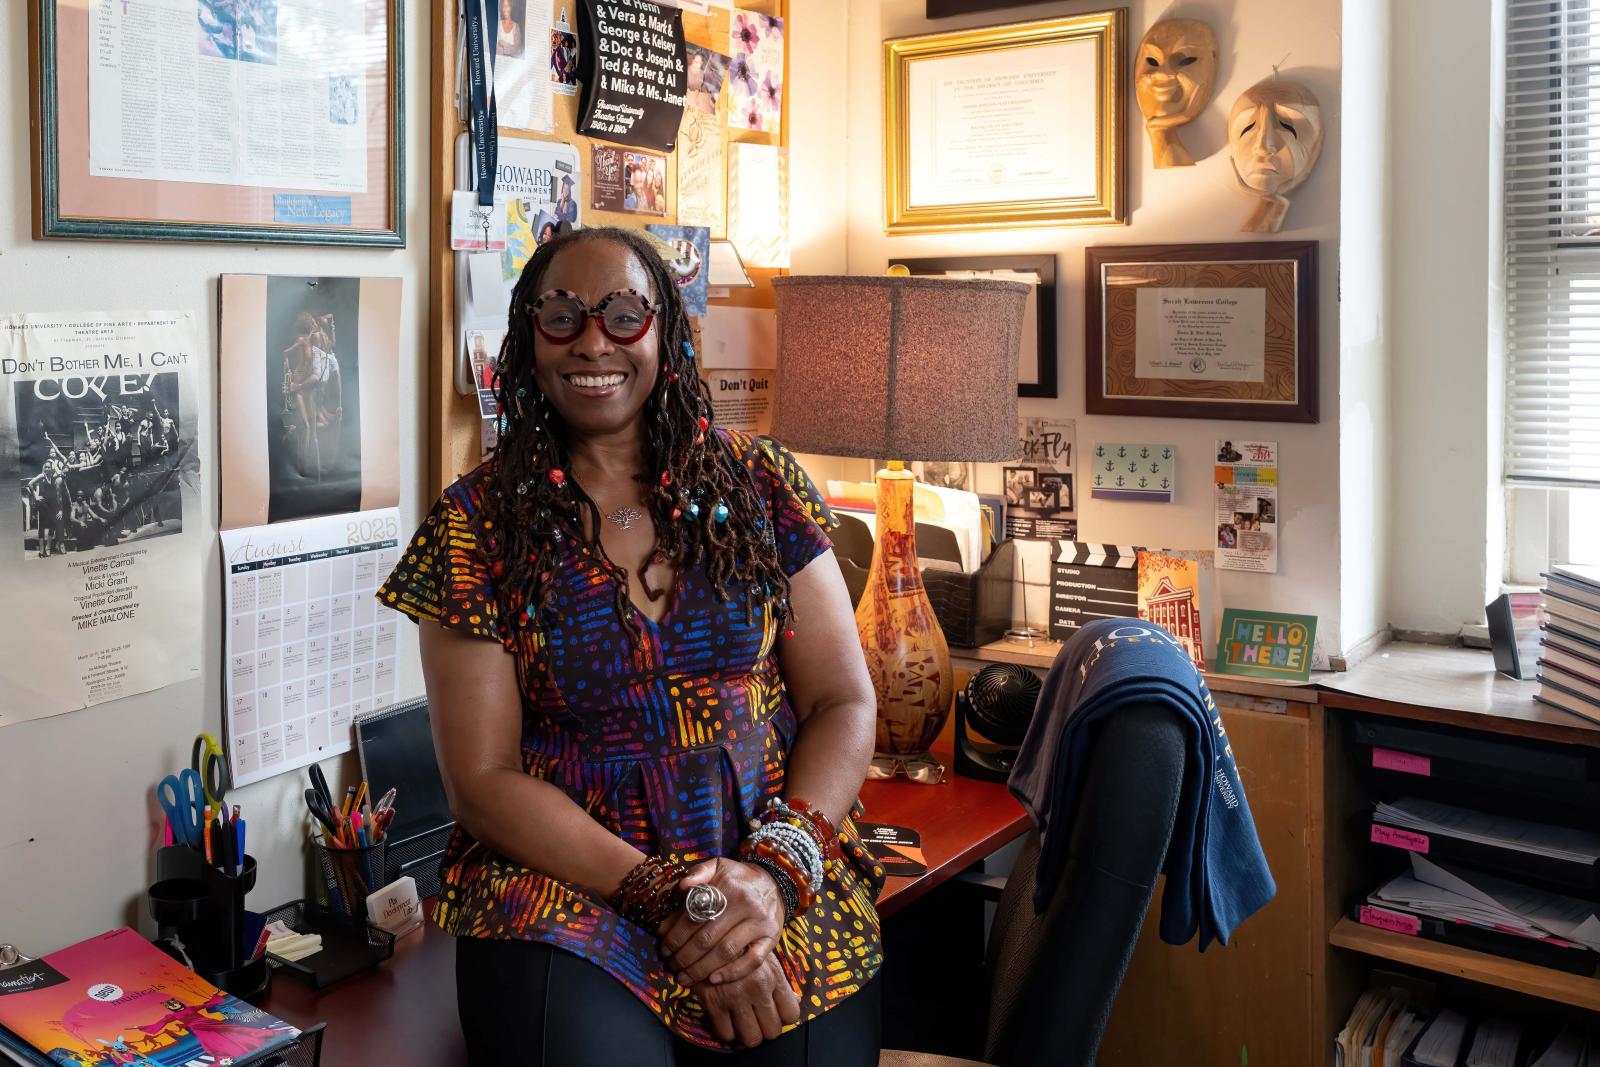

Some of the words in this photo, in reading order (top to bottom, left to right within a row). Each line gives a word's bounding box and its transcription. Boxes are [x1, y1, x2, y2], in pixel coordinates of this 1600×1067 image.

[597, 5, 607, 19] &
[608, 6, 636, 24] Vera
[639, 13, 647, 28] &
[649, 15, 668, 35] Mark
[667, 24, 674, 38] &
[471, 20, 480, 56] University
[598, 20, 640, 44] George
[643, 31, 650, 45] &
[652, 33, 676, 56] Kelsey
[599, 38, 610, 52] &
[611, 41, 633, 57] Doc
[636, 46, 643, 61] &
[646, 49, 674, 72] Joseph
[676, 59, 684, 73] &
[600, 56, 620, 73] Ted
[632, 63, 657, 81] Peter
[658, 71, 665, 85] &
[666, 74, 677, 88] Al
[601, 75, 608, 90] &
[611, 77, 635, 95] Mike
[637, 81, 645, 96] &
[646, 84, 662, 100] Ms.
[663, 89, 687, 107] Janet
[478, 114, 486, 150] University
[496, 164, 552, 187] HOWARD
[496, 184, 552, 195] NTERTAINMENT
[287, 205, 309, 217] New
[313, 206, 346, 223] Legacy
[138, 353, 143, 367] I
[720, 379, 747, 391] Don't
[749, 378, 769, 393] Quit
[1040, 432, 1072, 467] Fly
[230, 535, 304, 563] August
[346, 516, 398, 545] 2025
[82, 563, 108, 575] Vinette
[110, 557, 135, 569] Carroll
[263, 560, 277, 569] Monday
[310, 551, 329, 559] Wednesday
[88, 574, 102, 582] Music
[106, 571, 120, 579] Lyrics
[1057, 567, 1081, 576] STUDIO
[85, 580, 105, 592] Micki
[107, 576, 128, 587] Grant
[1056, 580, 1097, 590] PRODUCTION
[80, 598, 106, 610] Vinette
[107, 591, 133, 604] Carroll
[1055, 593, 1087, 602] DIRECTOR
[71, 612, 92, 622] Directed
[1055, 605, 1081, 614] CAMERA
[77, 617, 99, 631] MIKE
[99, 609, 136, 625] MALONE
[1058, 618, 1076, 627] DATE
[1235, 623, 1303, 646] HELLO
[1231, 642, 1302, 668] THERE
[238, 738, 245, 747] 24
[1216, 768, 1239, 808] HOWARD
[1375, 826, 1390, 840] Play
[111, 983, 167, 1007] musicals
